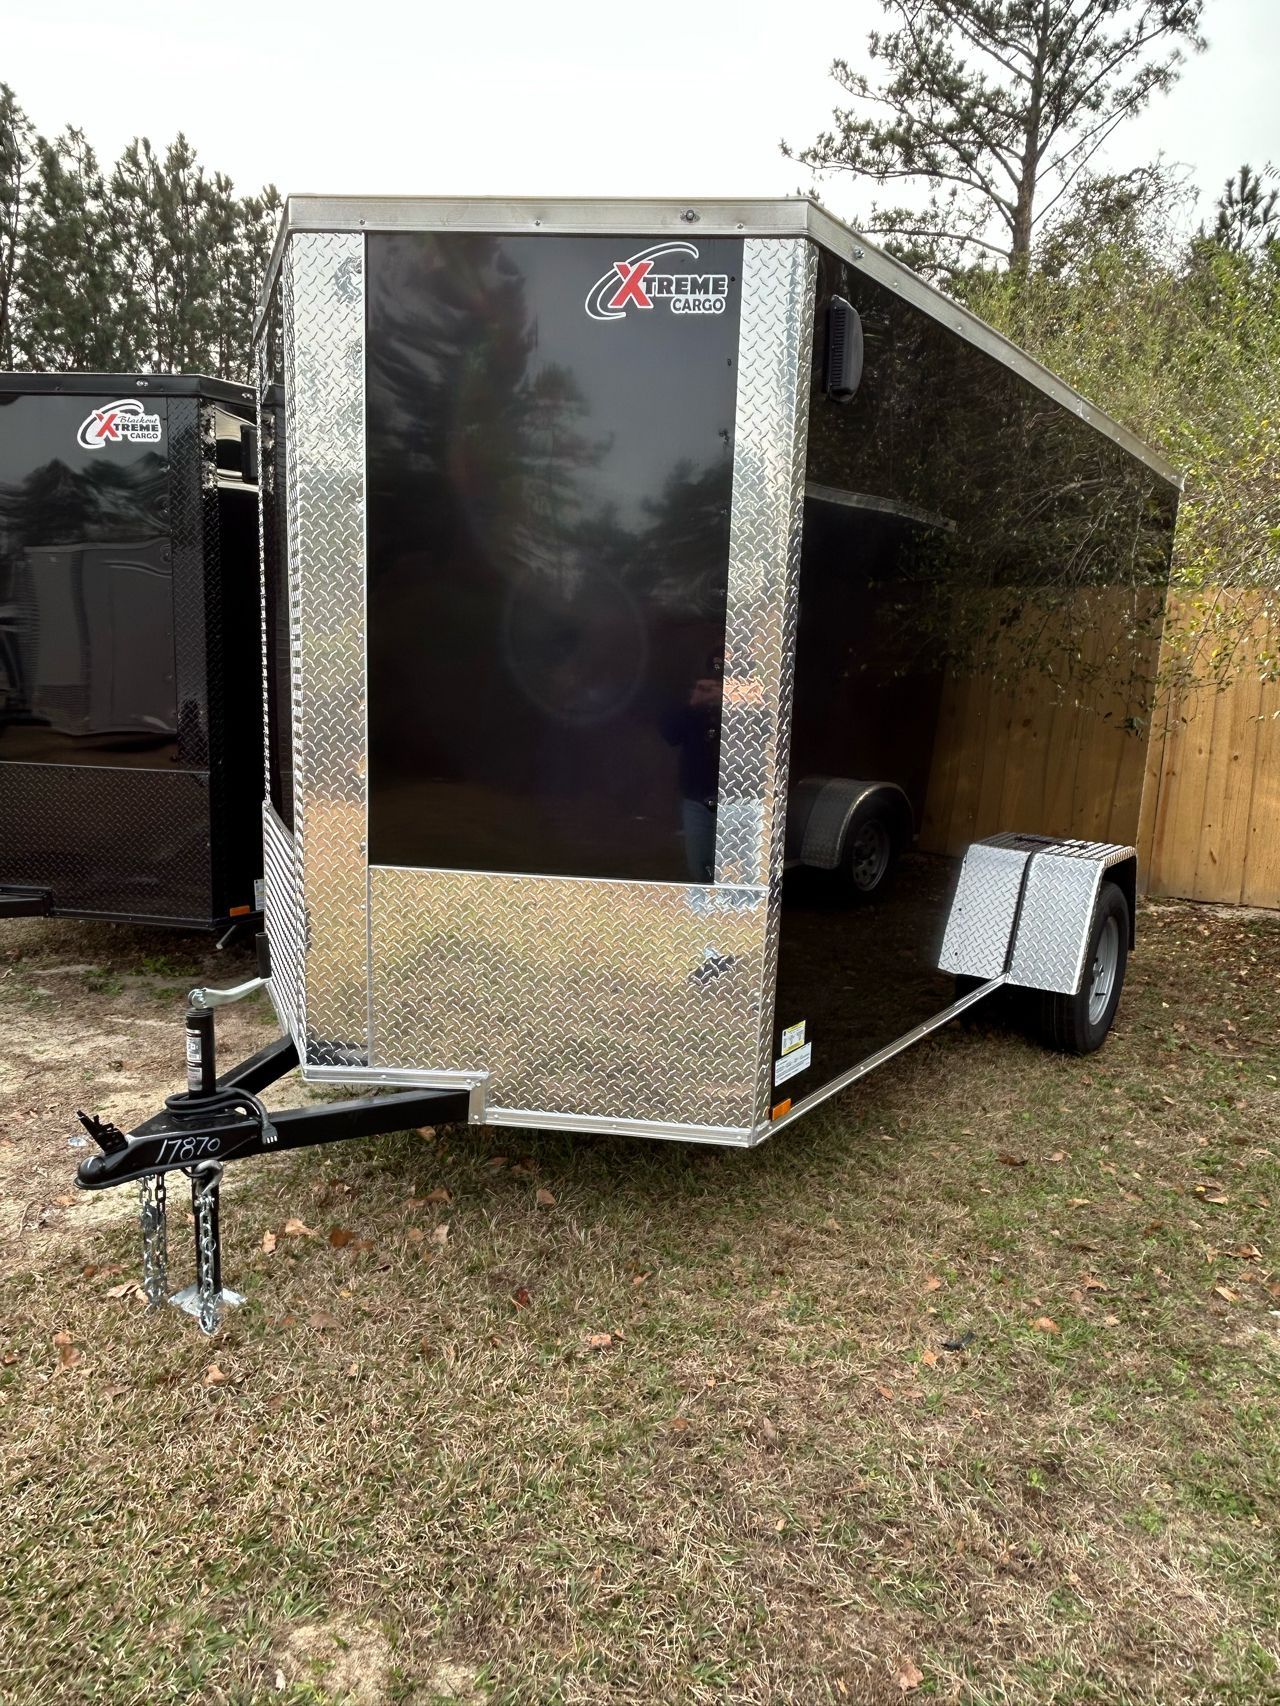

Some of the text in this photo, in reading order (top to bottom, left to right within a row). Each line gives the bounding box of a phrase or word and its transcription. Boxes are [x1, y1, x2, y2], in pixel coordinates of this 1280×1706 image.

[608, 261, 728, 309] XTREME
[671, 297, 726, 313] CARGO
[95, 413, 159, 438] XTREME
[118, 415, 158, 424] Blackout
[130, 432, 159, 440] CARGO
[155, 1136, 221, 1165] 17870
